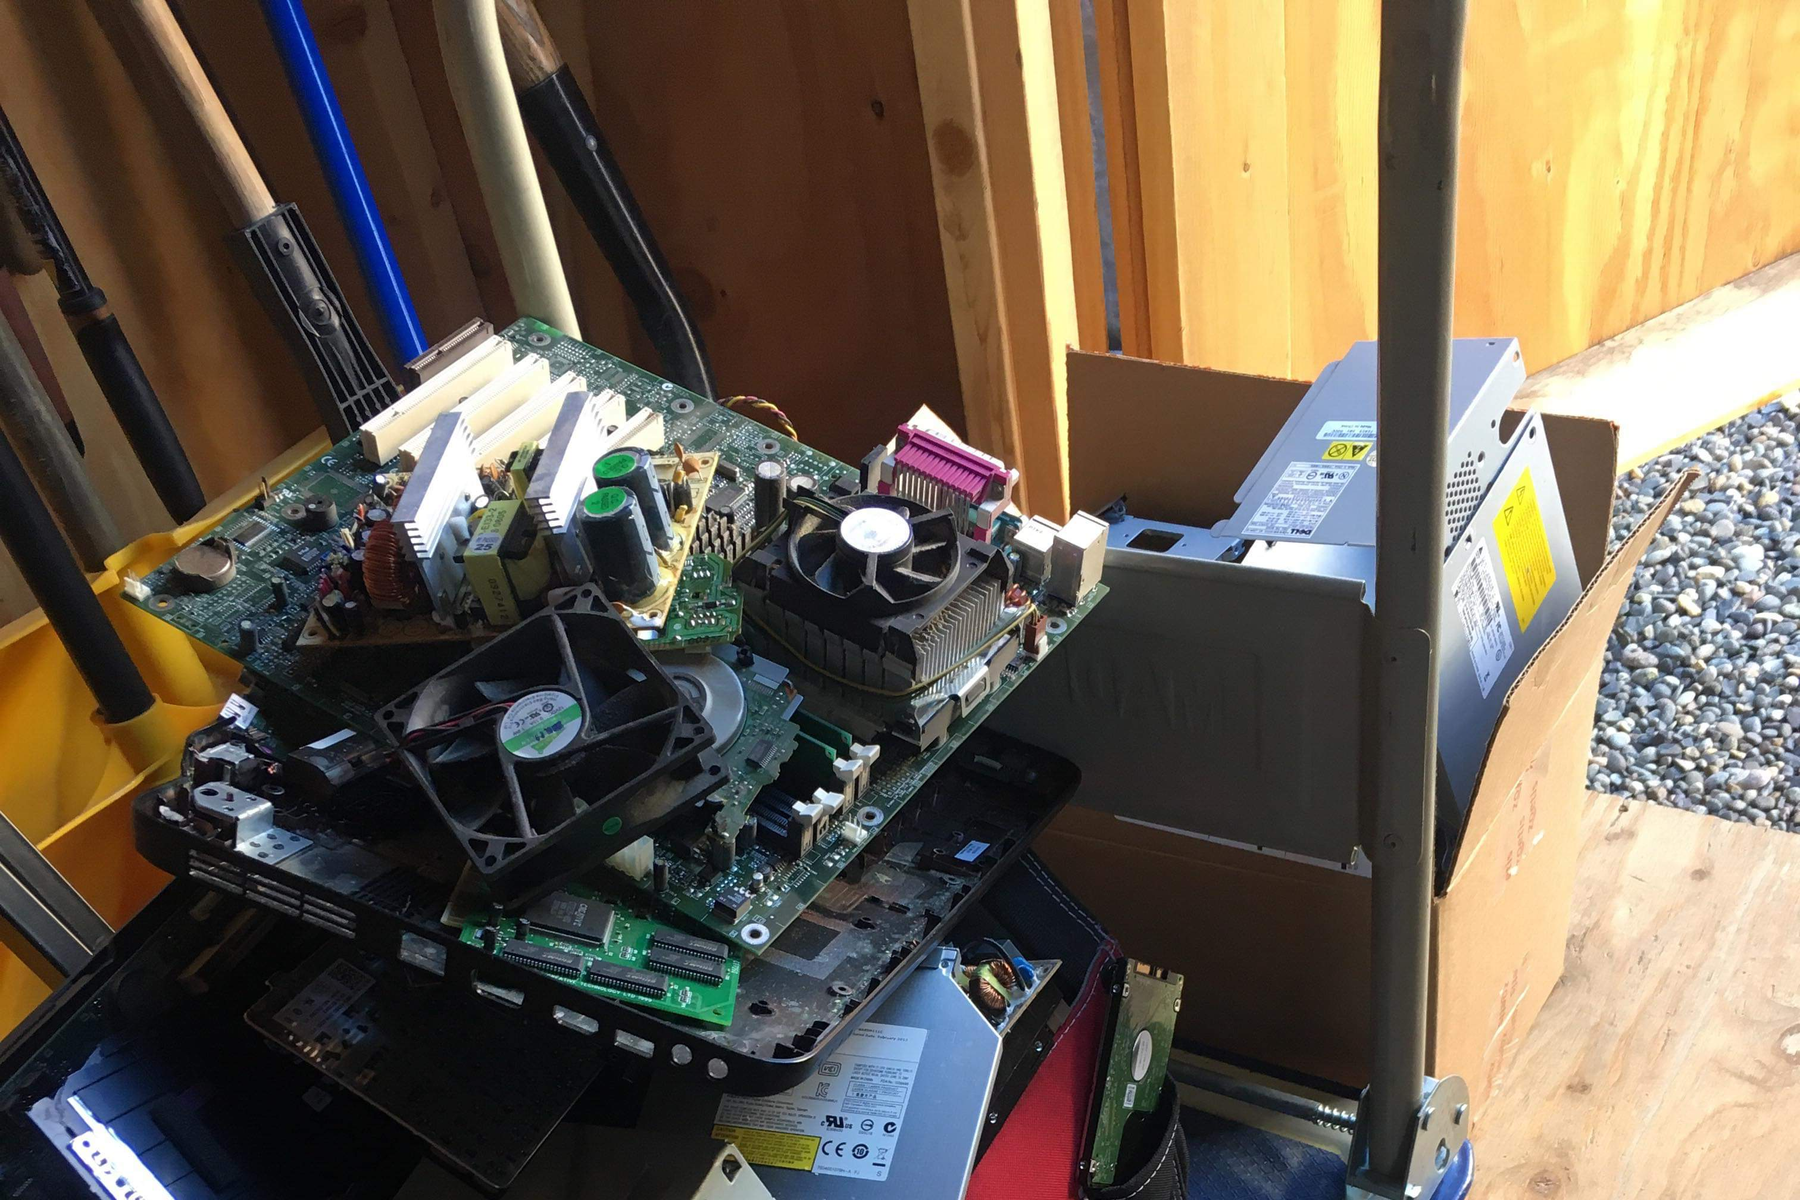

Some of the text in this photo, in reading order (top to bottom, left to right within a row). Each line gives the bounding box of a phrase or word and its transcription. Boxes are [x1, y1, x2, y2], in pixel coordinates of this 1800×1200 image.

[1290, 528, 1312, 536] DELL
[474, 543, 493, 551] 25
[580, 981, 621, 995] TECHNOLOGY
[821, 1140, 847, 1157] CE
